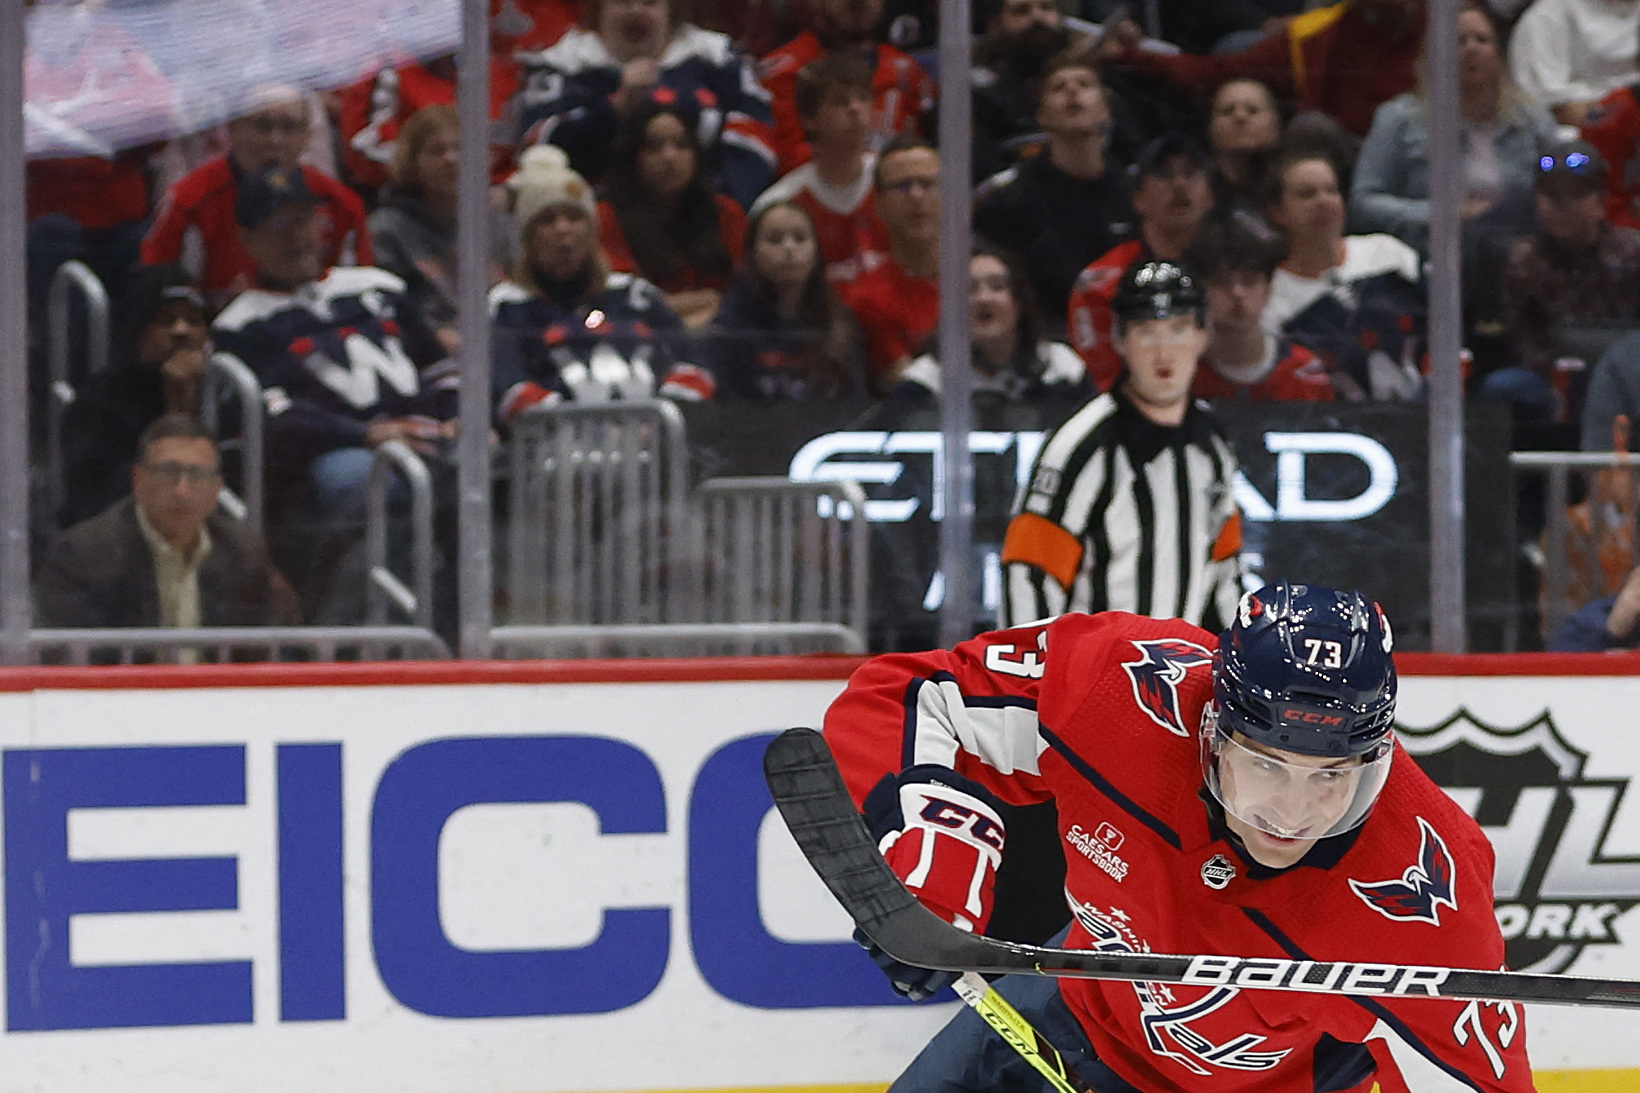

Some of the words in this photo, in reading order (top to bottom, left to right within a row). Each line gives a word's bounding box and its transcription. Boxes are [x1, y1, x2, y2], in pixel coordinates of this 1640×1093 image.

[1304, 638, 1342, 668] 73
[1283, 709, 1344, 726] CCM
[918, 793, 1006, 852] CC
[1065, 832, 1128, 884] SPORTSBOOK
[1071, 825, 1128, 873] CAESARS
[984, 1010, 1035, 1056] CCM
